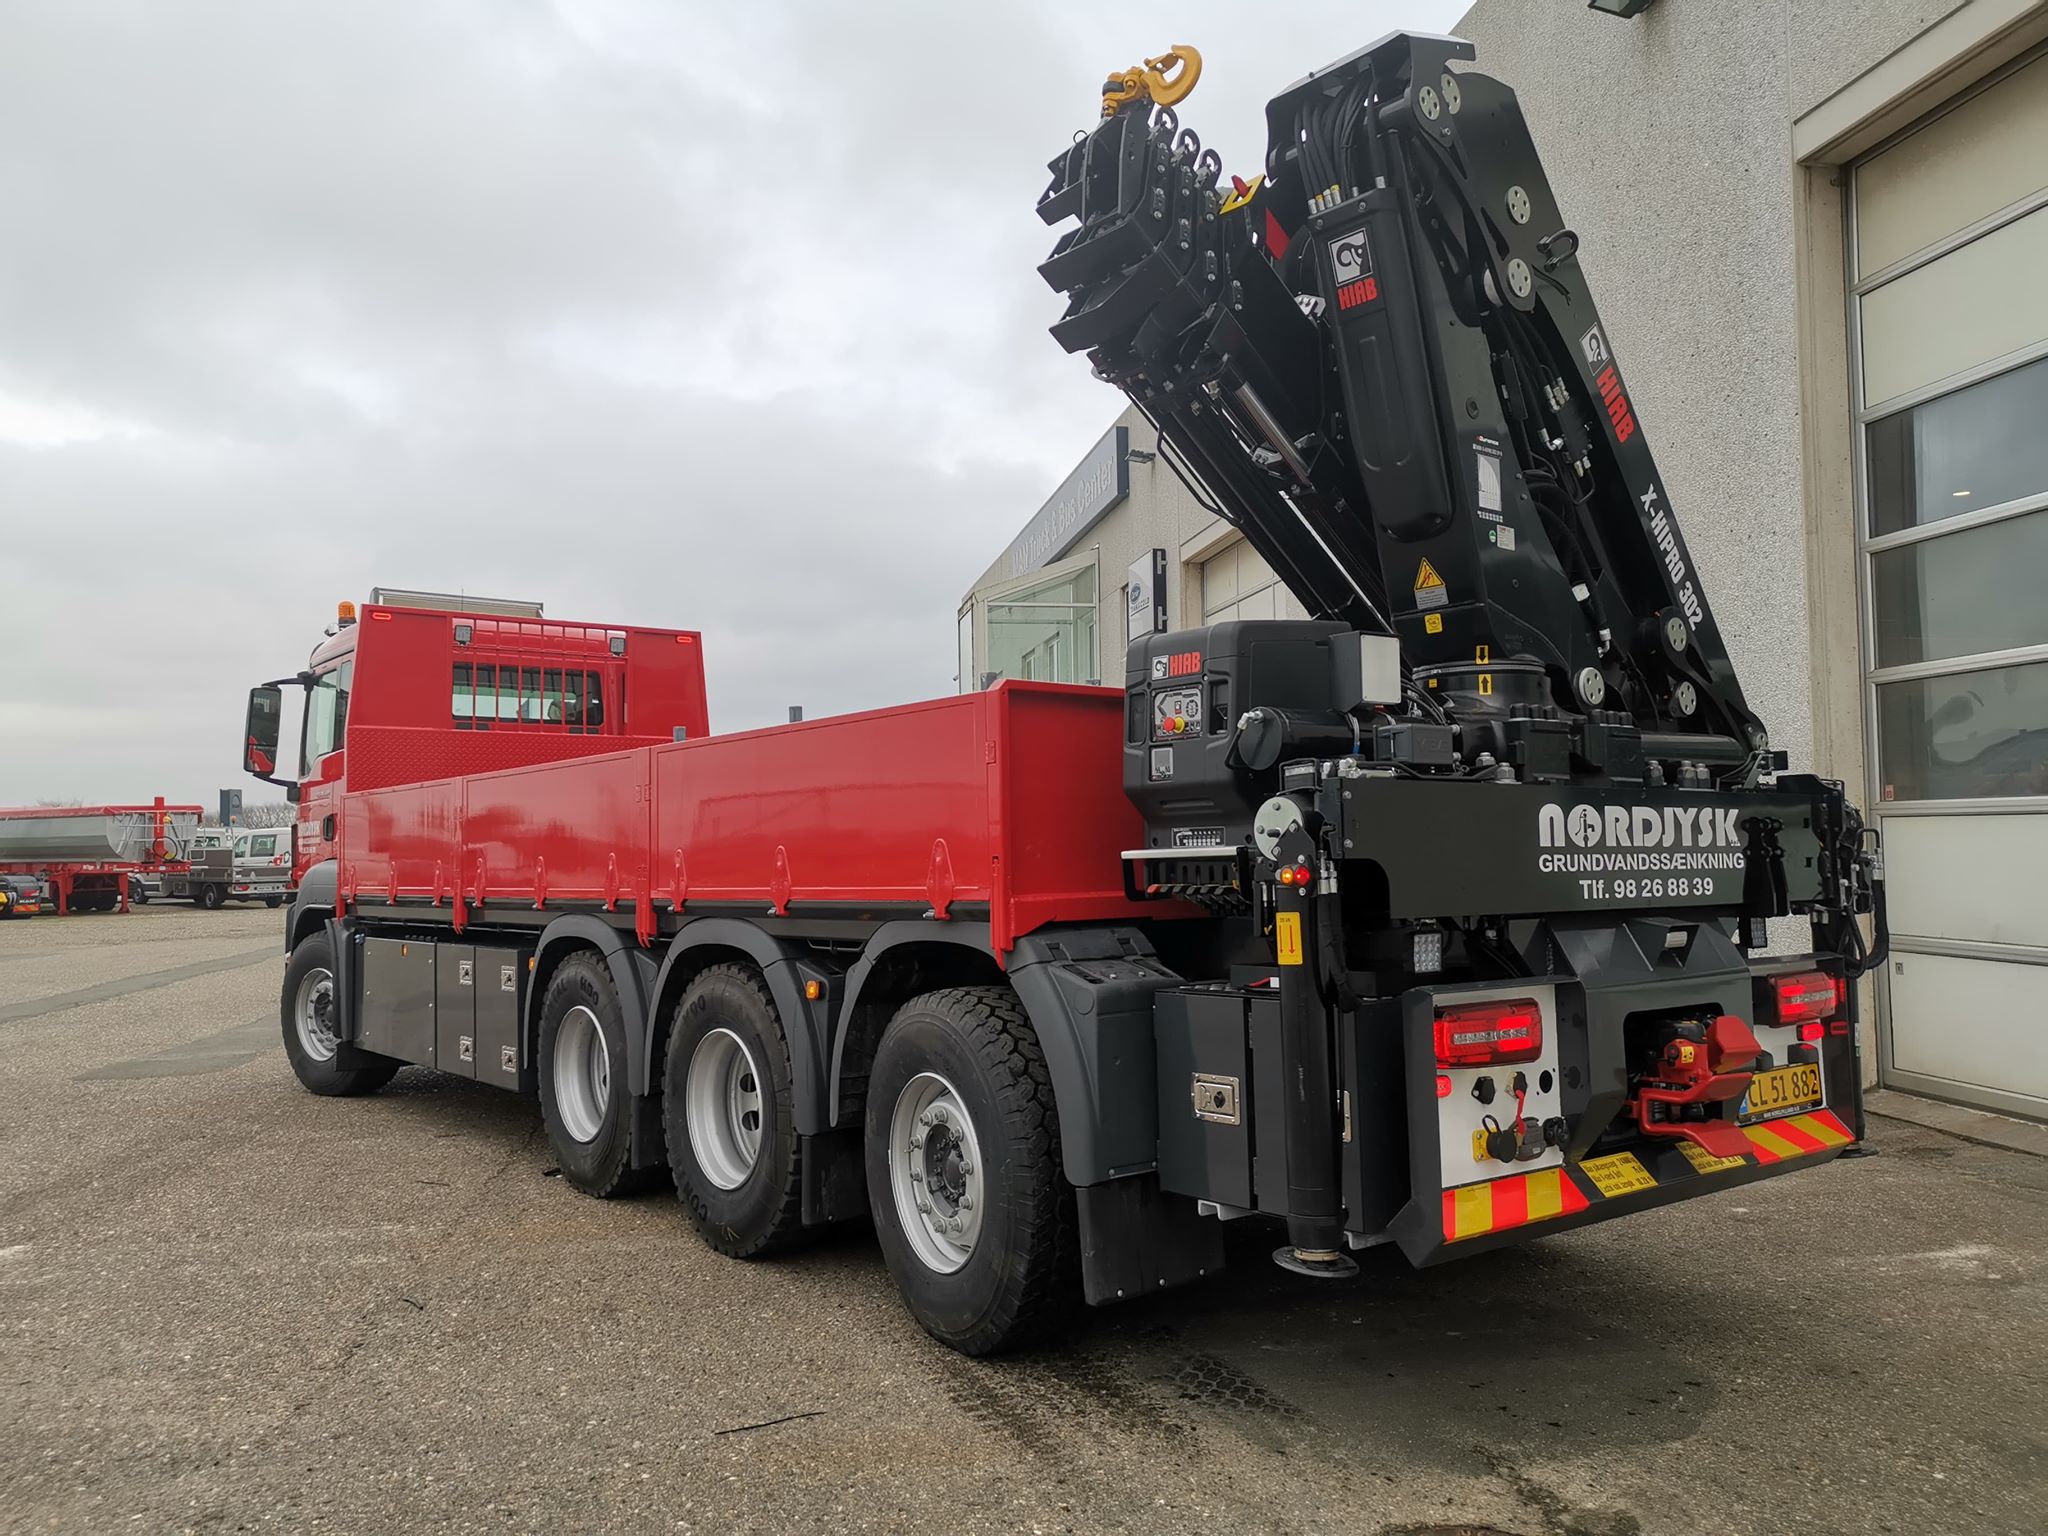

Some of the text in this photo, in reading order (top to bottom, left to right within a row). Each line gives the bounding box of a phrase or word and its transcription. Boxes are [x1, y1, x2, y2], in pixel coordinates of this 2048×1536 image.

[1337, 278, 1378, 310] HIAB
[1596, 365, 1635, 443] HIAB
[1029, 519, 1051, 562] Truck
[1059, 498, 1076, 535] Bus
[1077, 456, 1114, 514] Center
[1640, 483, 1704, 631] X-HIPRO 302
[1169, 652, 1201, 676] HIAB
[1538, 803, 1740, 847] NORDJYSK
[1538, 852, 1745, 872] GRUNDVANDSSÆNKNING
[1578, 876, 1714, 899] Tlf. 98 26 88 39
[1747, 1068, 1819, 1107] CL 51 882
